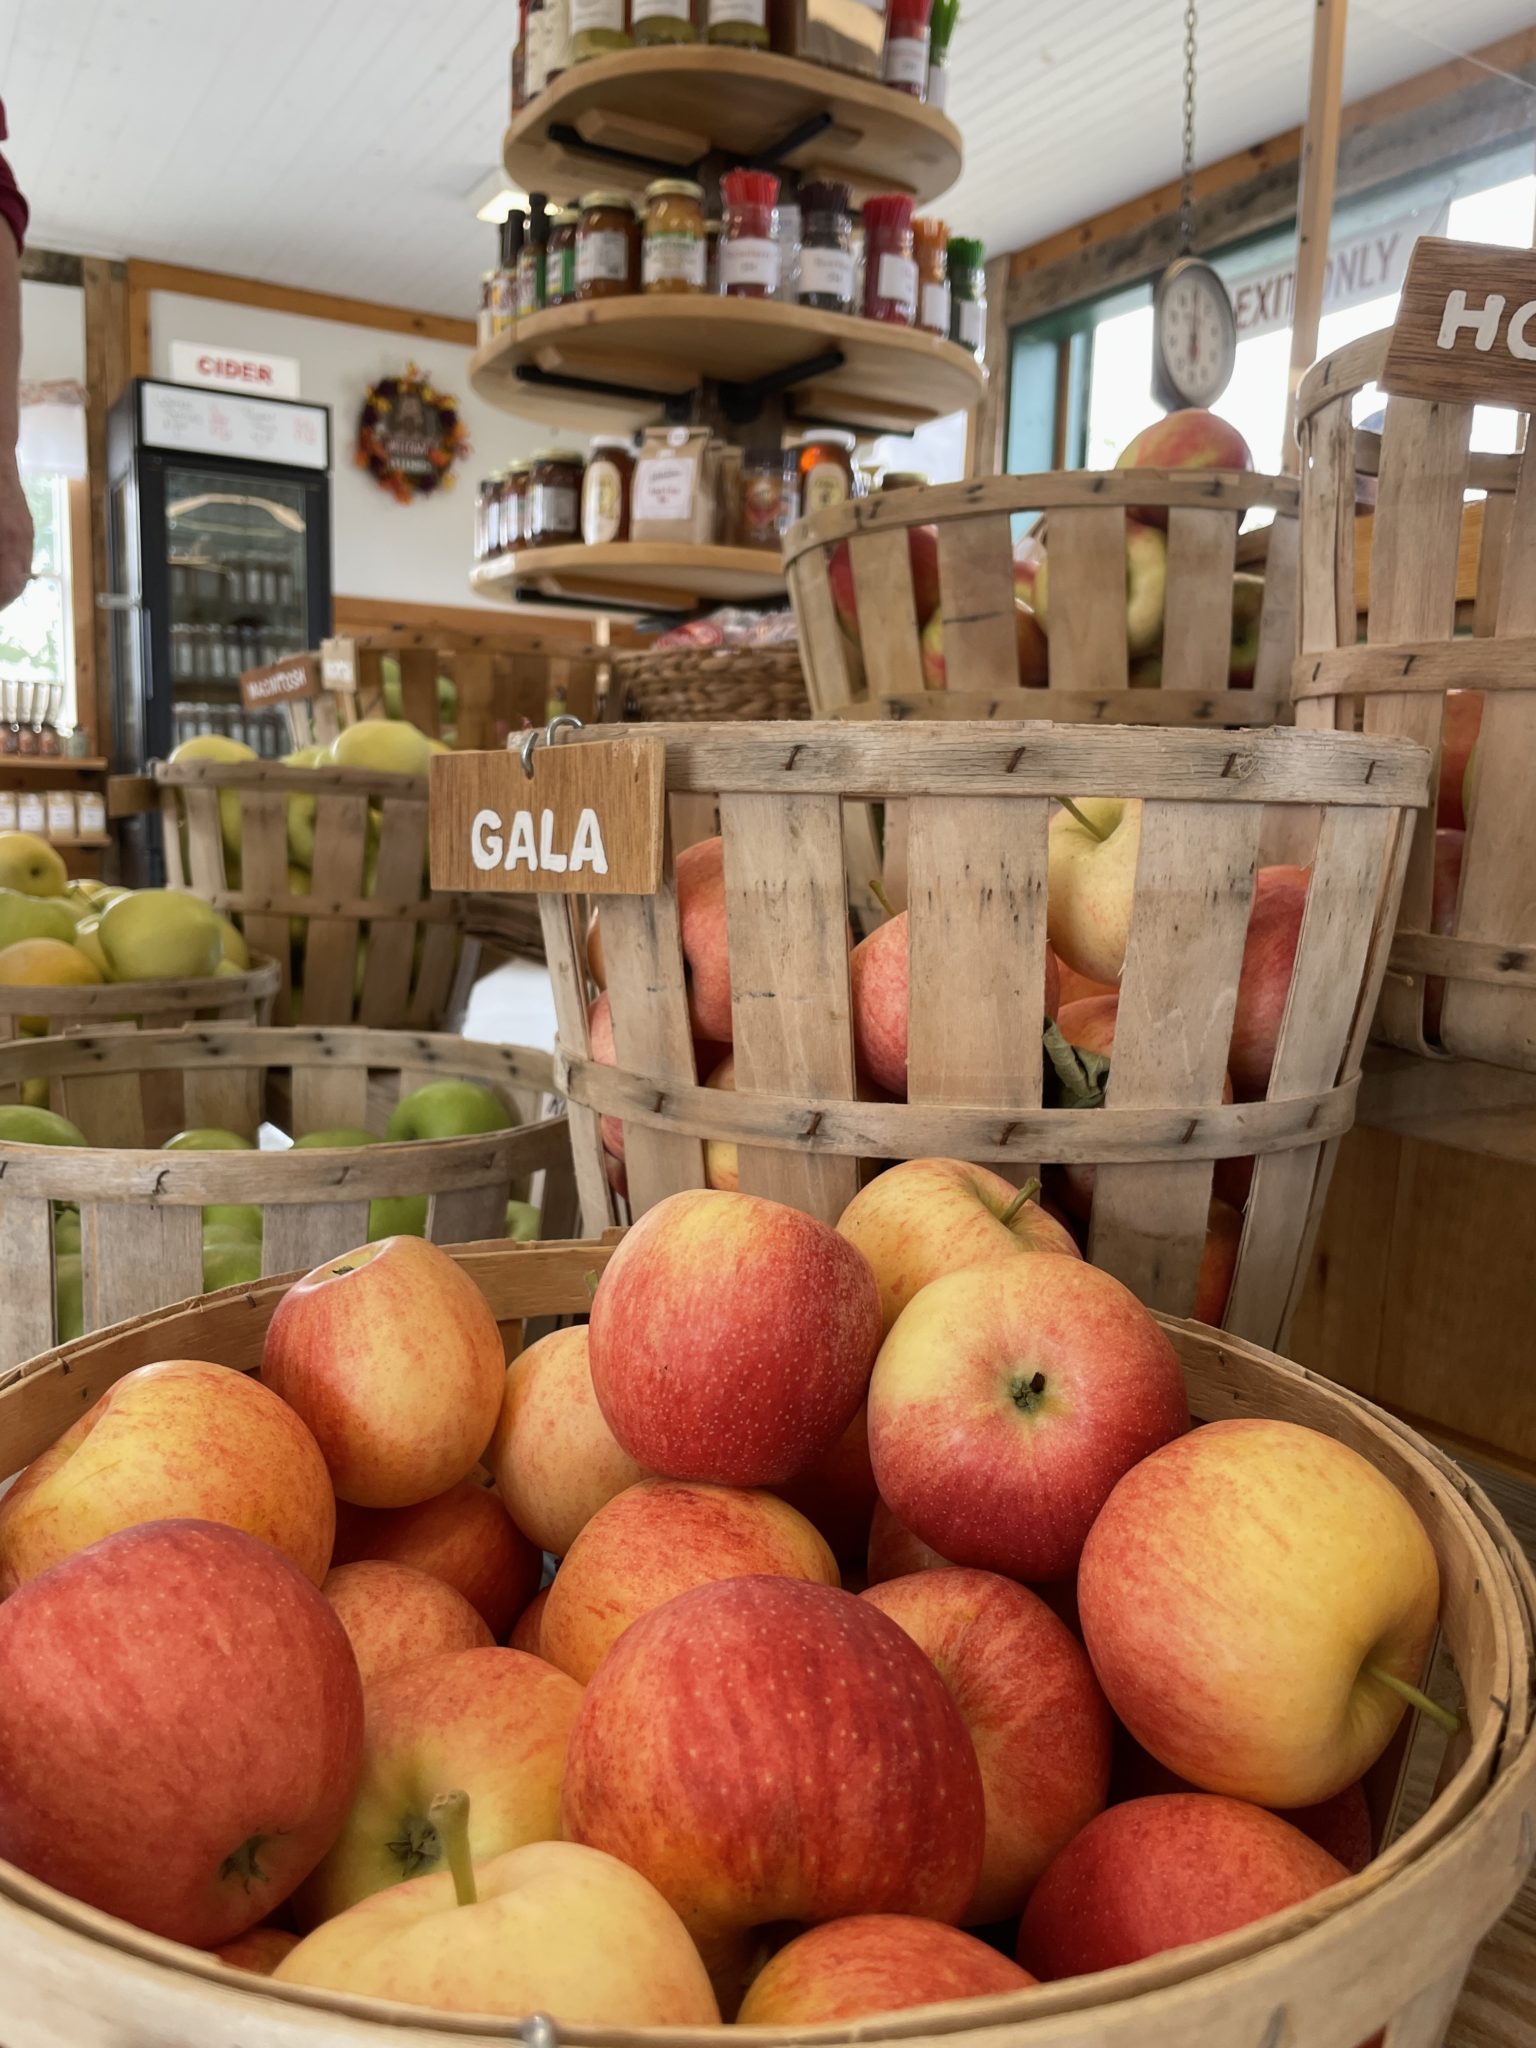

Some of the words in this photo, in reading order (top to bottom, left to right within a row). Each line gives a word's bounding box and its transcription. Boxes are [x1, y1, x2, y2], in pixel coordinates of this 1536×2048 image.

[1236, 272, 1295, 329] EXIT
[198, 355, 273, 383] CIDER
[471, 808, 608, 874] GALA
